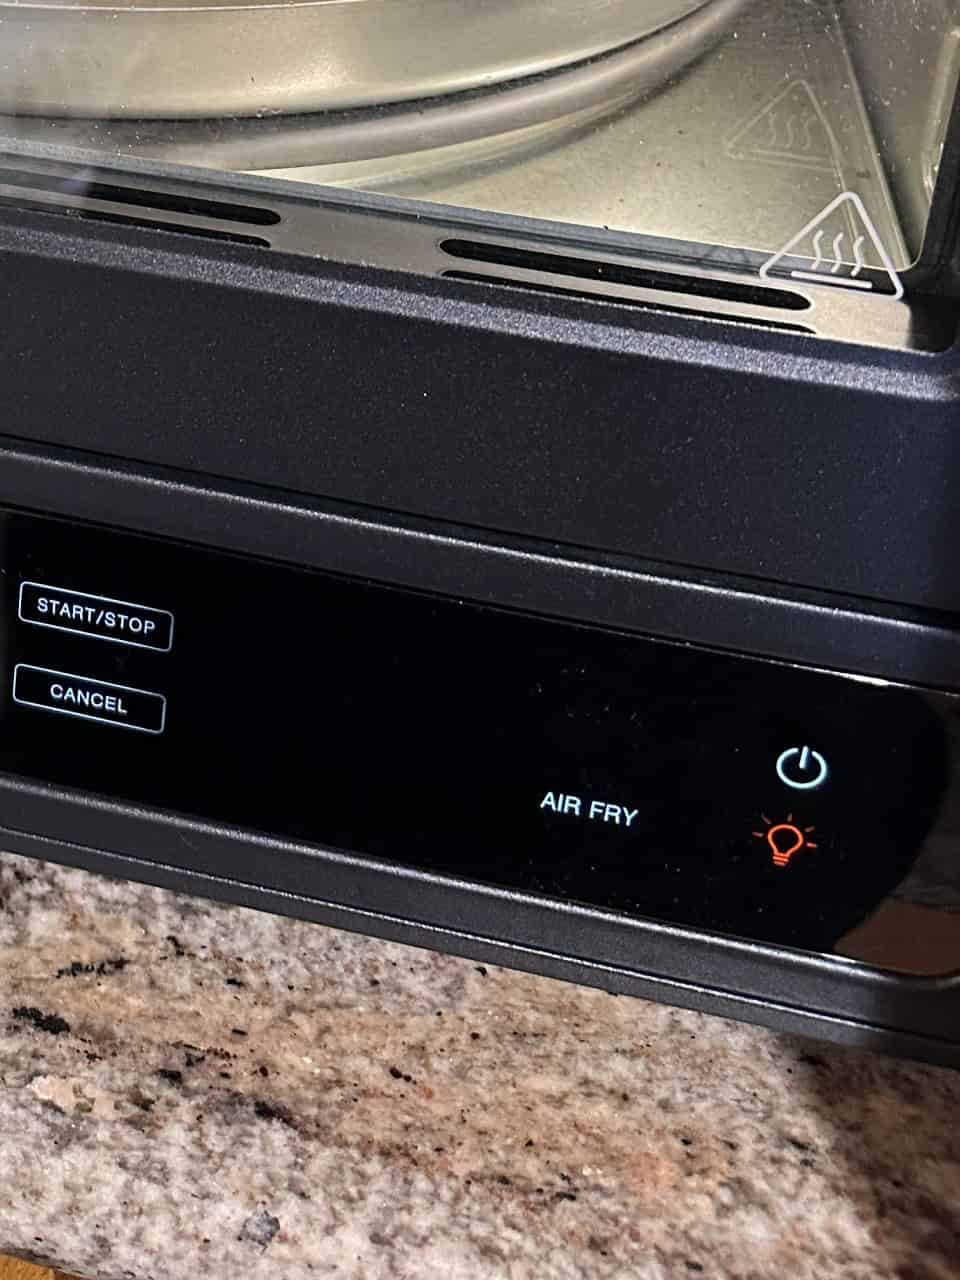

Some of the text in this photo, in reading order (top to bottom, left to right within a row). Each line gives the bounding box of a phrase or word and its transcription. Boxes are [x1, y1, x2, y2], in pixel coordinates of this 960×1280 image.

[36, 597, 156, 635] START/STOP
[50, 683, 128, 716] CANCEL
[540, 791, 639, 827] AIR FRY
